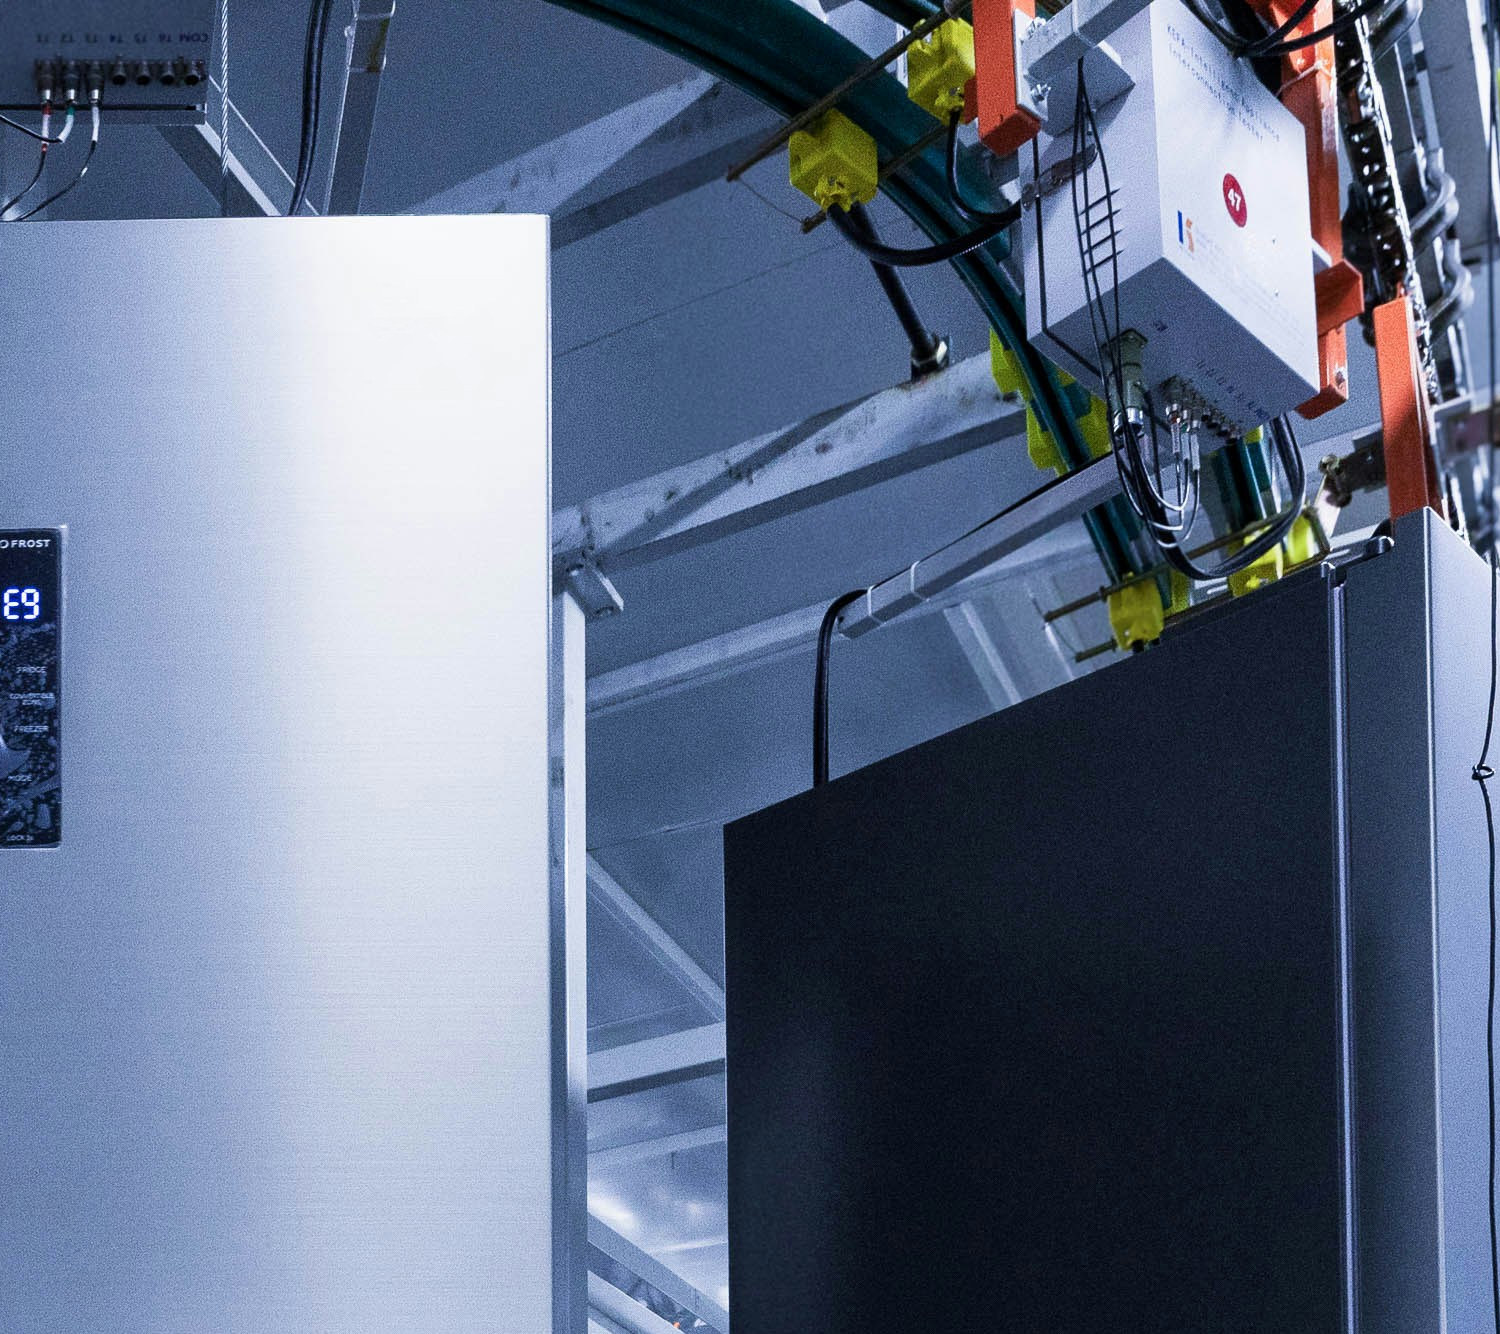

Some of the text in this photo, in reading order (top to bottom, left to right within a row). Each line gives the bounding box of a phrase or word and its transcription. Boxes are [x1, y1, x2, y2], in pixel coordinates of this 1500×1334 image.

[1227, 187, 1242, 212] 47
[10, 539, 50, 548] FROST
[3, 588, 40, 620] E9
